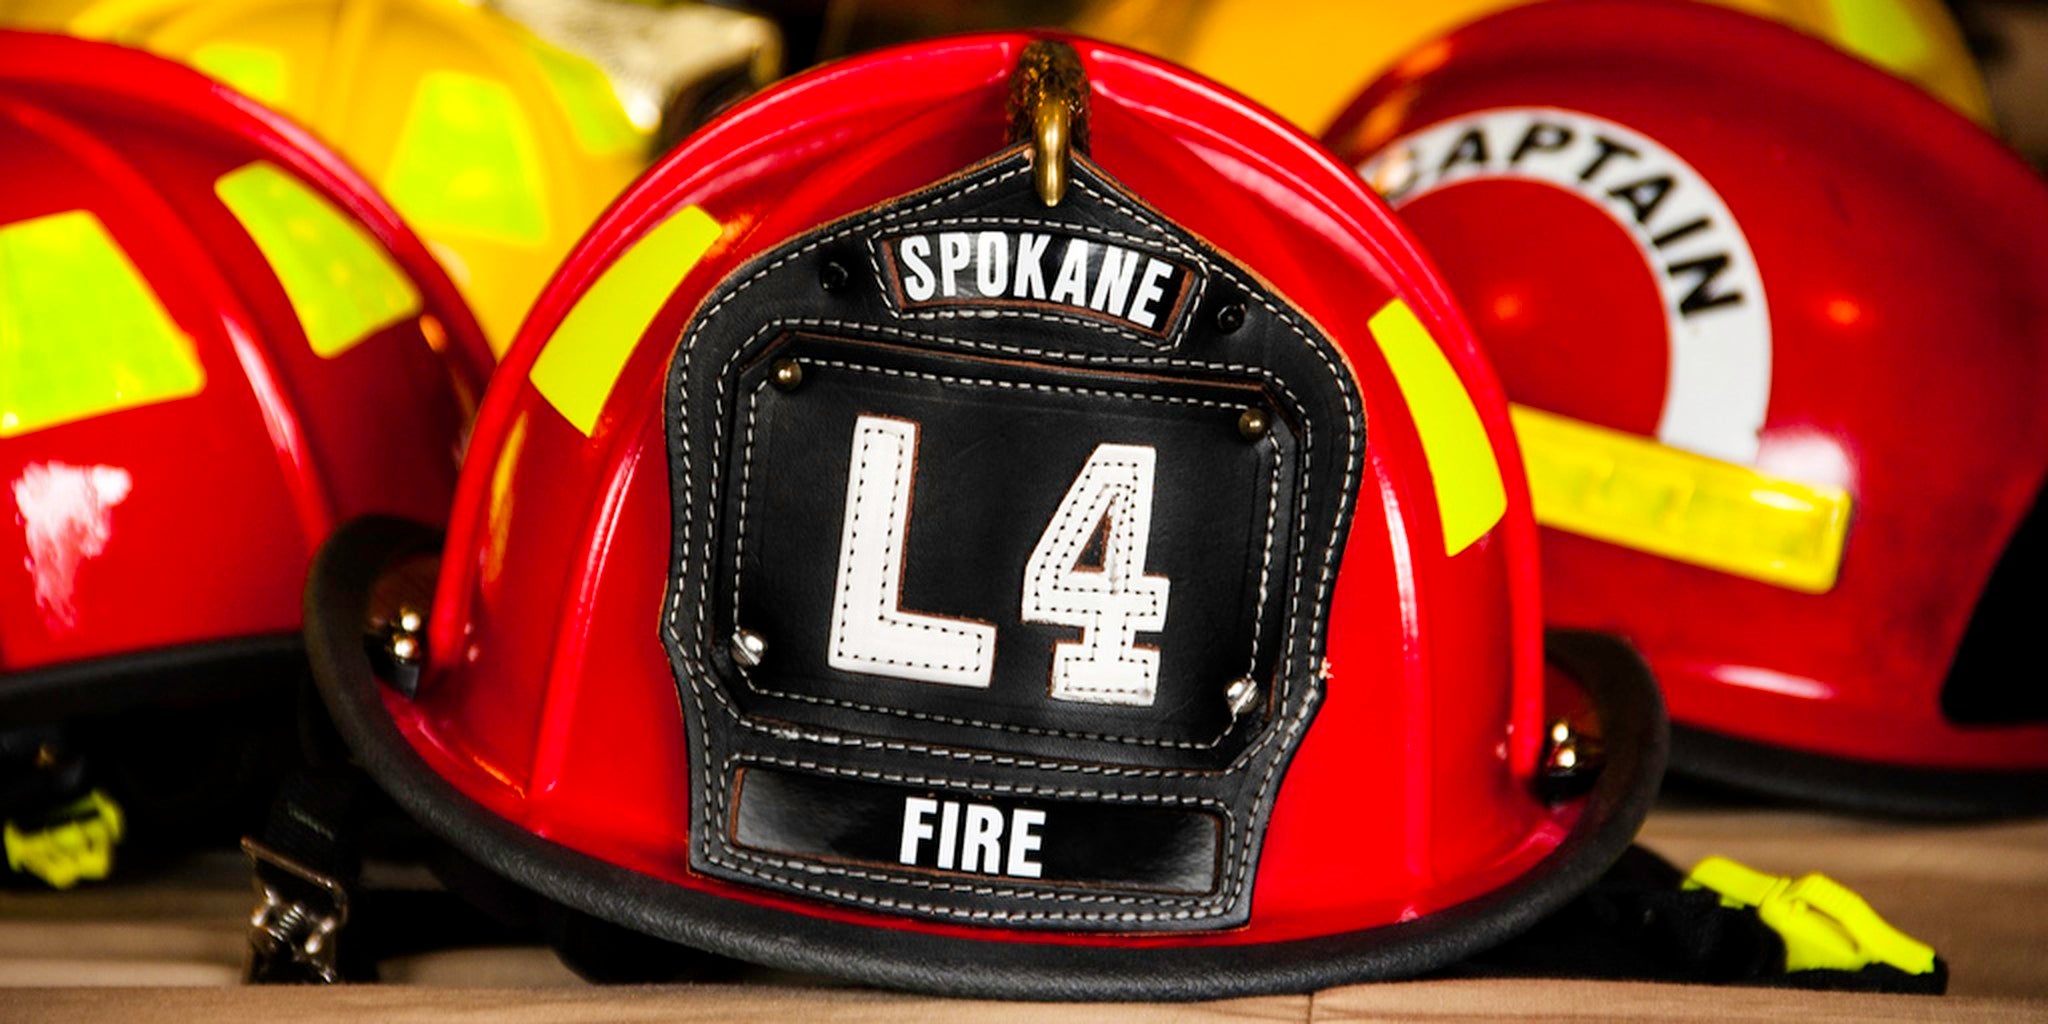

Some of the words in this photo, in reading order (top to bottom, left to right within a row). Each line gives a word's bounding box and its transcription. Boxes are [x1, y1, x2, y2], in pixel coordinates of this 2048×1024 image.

[900, 230, 1174, 329] SPOKANE
[828, 415, 1171, 707] L4
[899, 796, 1047, 878] FIRE
